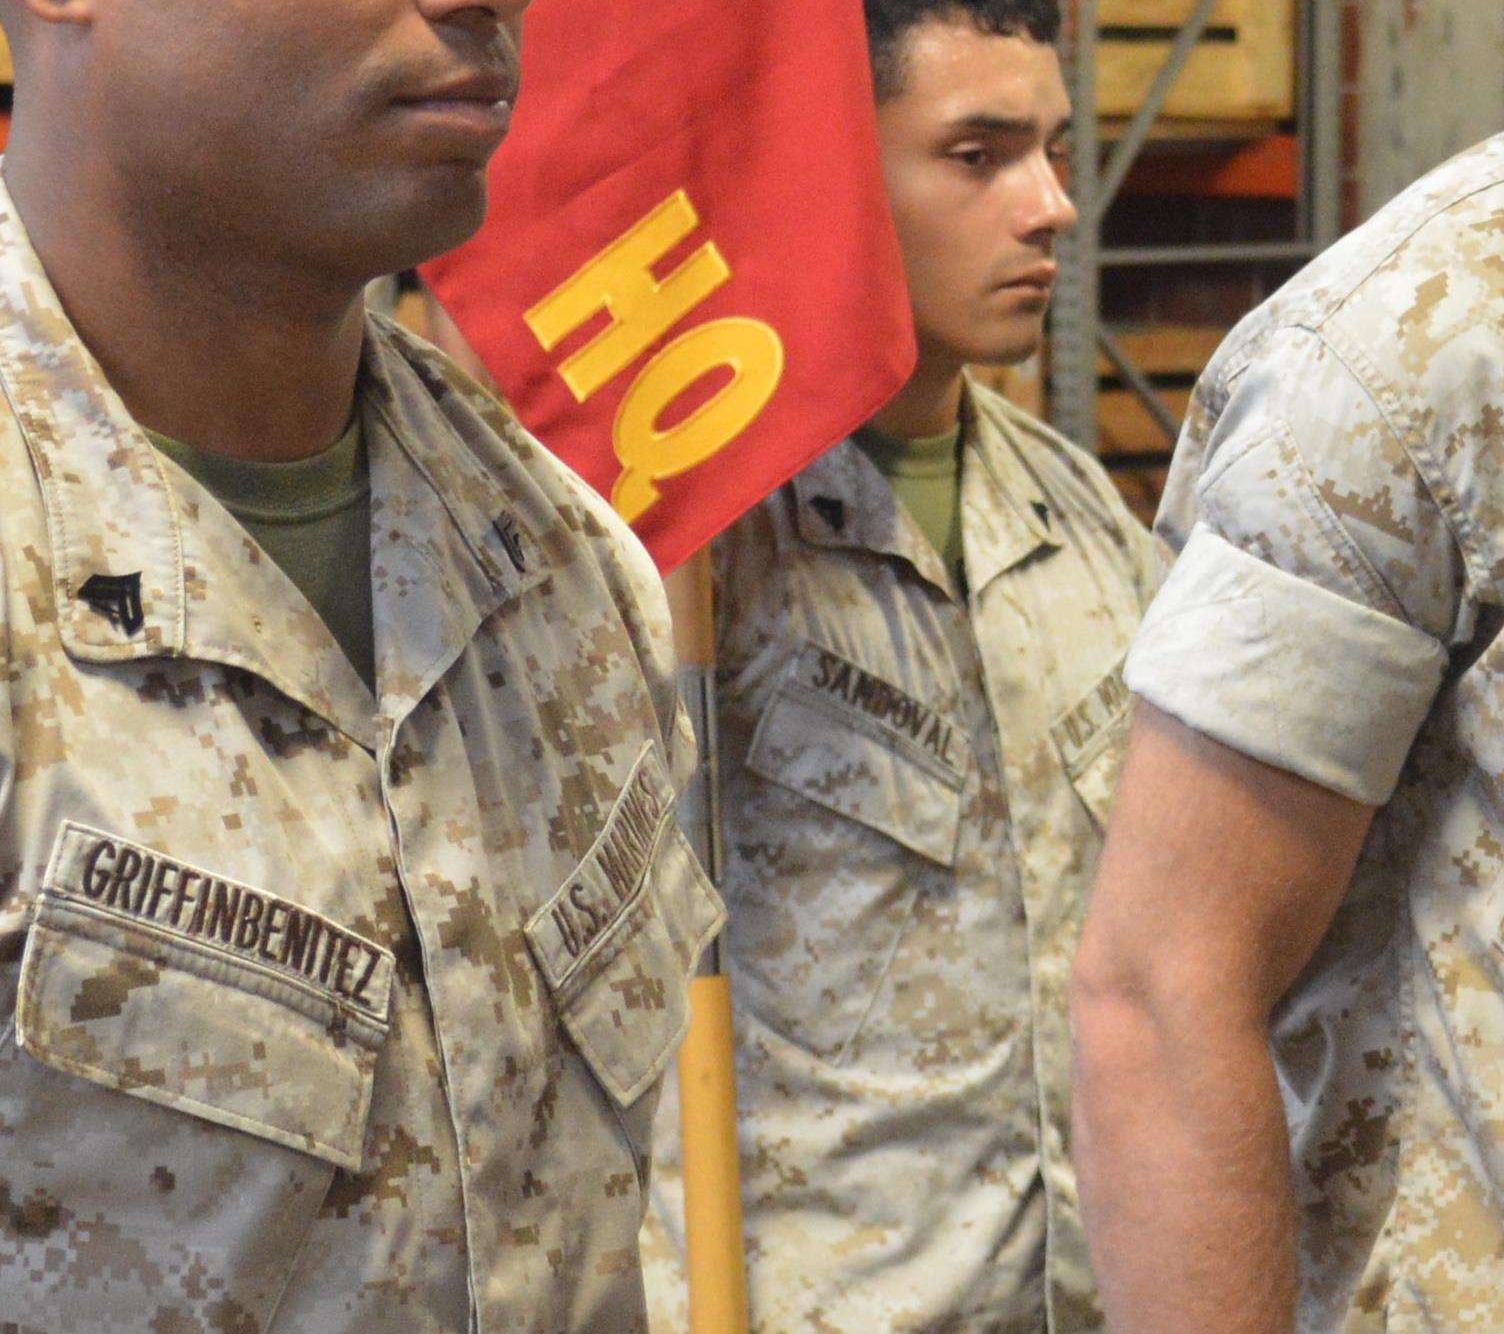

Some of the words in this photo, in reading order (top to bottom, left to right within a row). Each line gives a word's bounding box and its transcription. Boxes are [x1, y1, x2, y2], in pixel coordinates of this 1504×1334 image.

[522, 186, 784, 525] HQ
[812, 650, 954, 767] SANDOVAL
[82, 839, 381, 1007] GRIFFINBENITEZ
